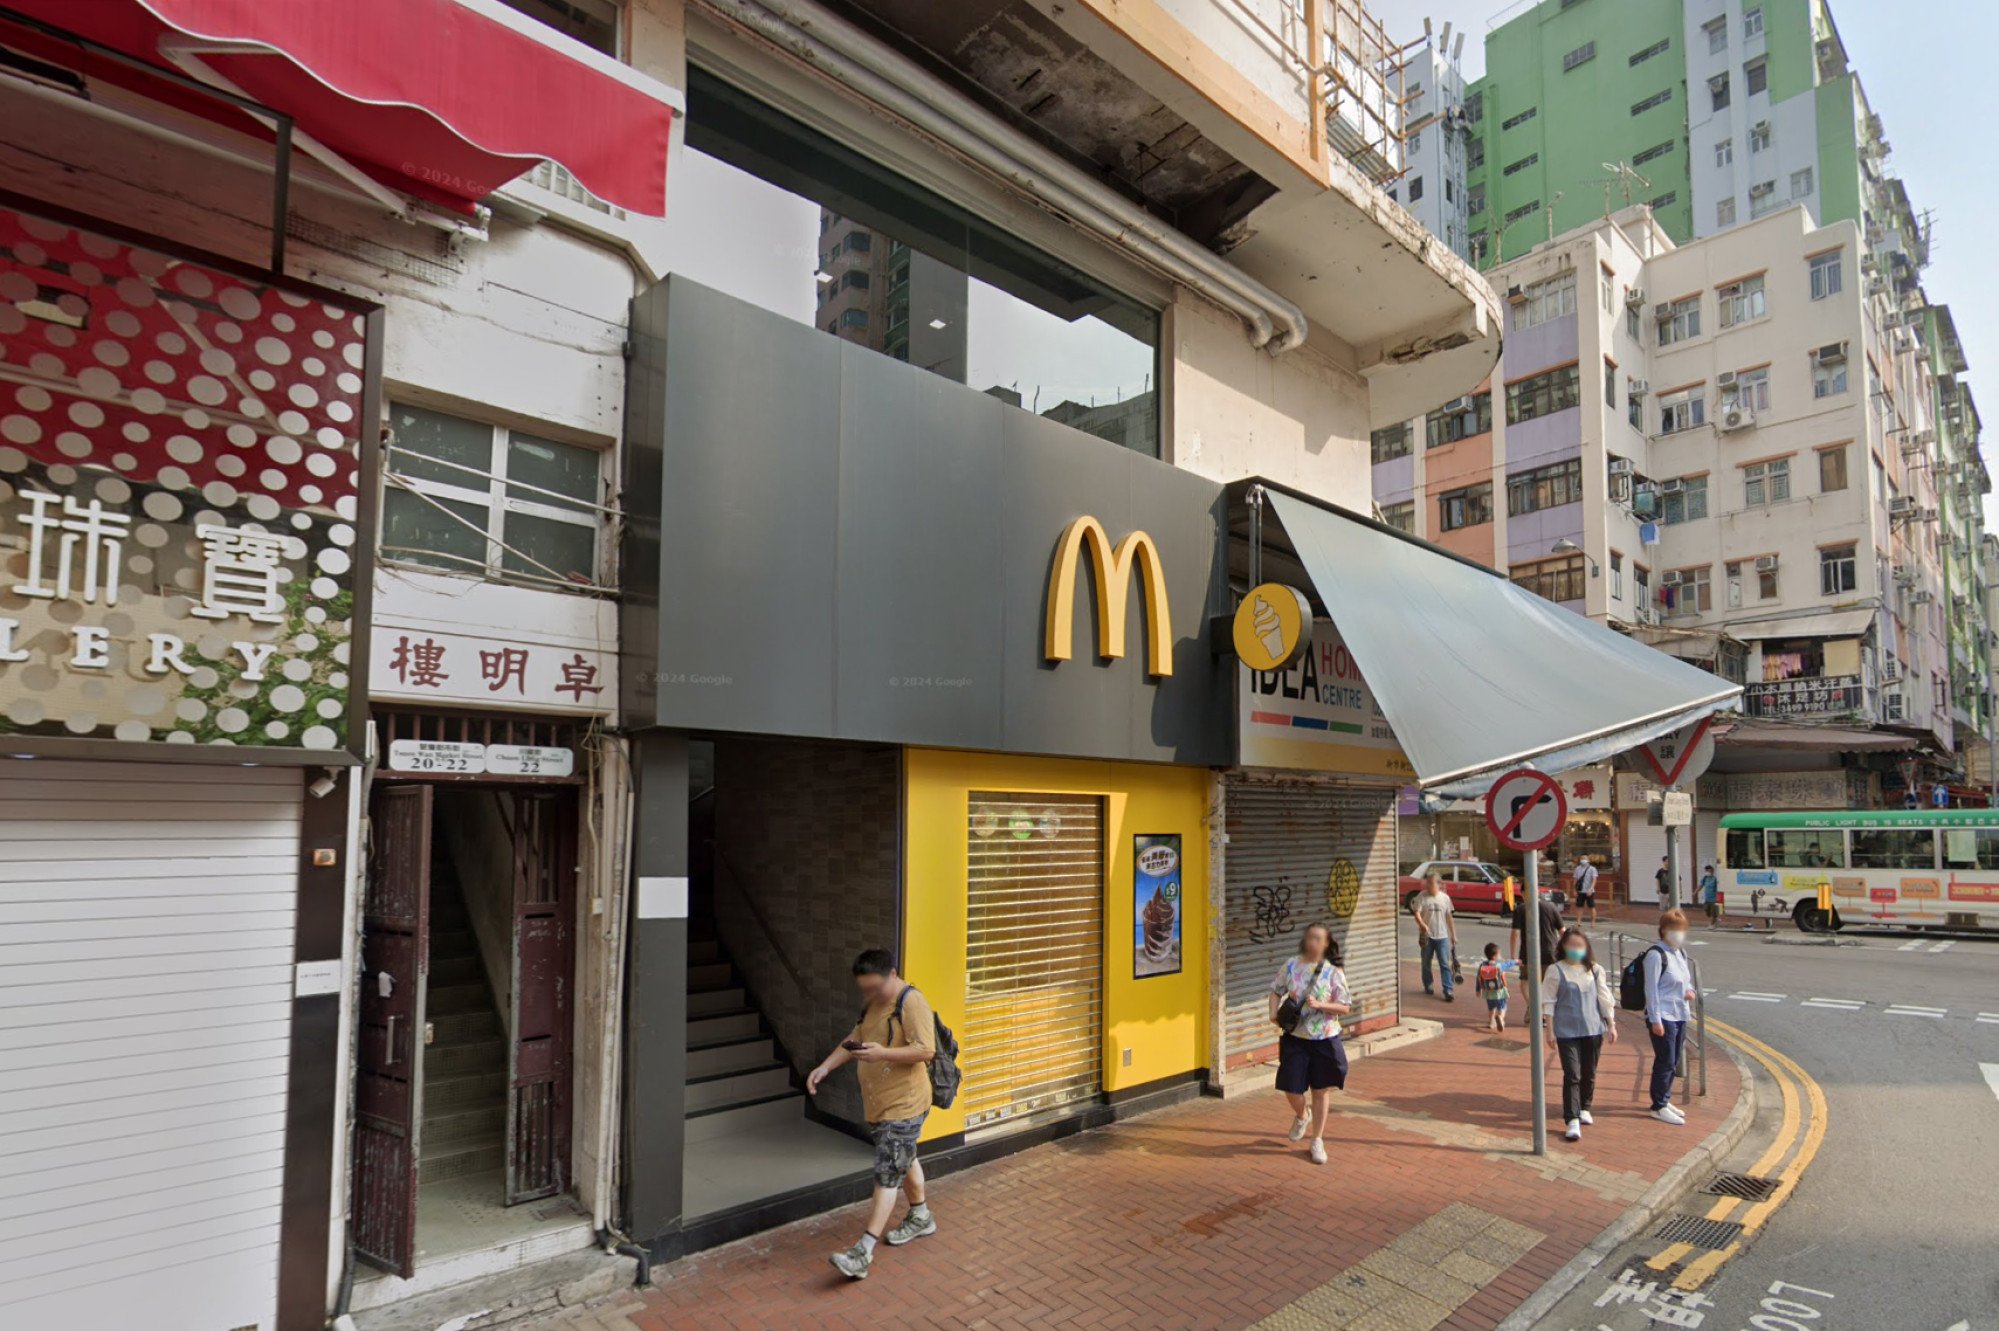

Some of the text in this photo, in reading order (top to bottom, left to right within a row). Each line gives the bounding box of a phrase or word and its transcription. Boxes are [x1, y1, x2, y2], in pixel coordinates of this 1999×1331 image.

[1044, 514, 1173, 677] M
[1321, 641, 1361, 682] HOM
[1322, 683, 1362, 710] CENTRE
[520, 762, 540, 773] 22
[1805, 819, 1831, 827] PUBLIC
[1897, 818, 1924, 826] SEATS
[1741, 1280, 1835, 1331] LOO
